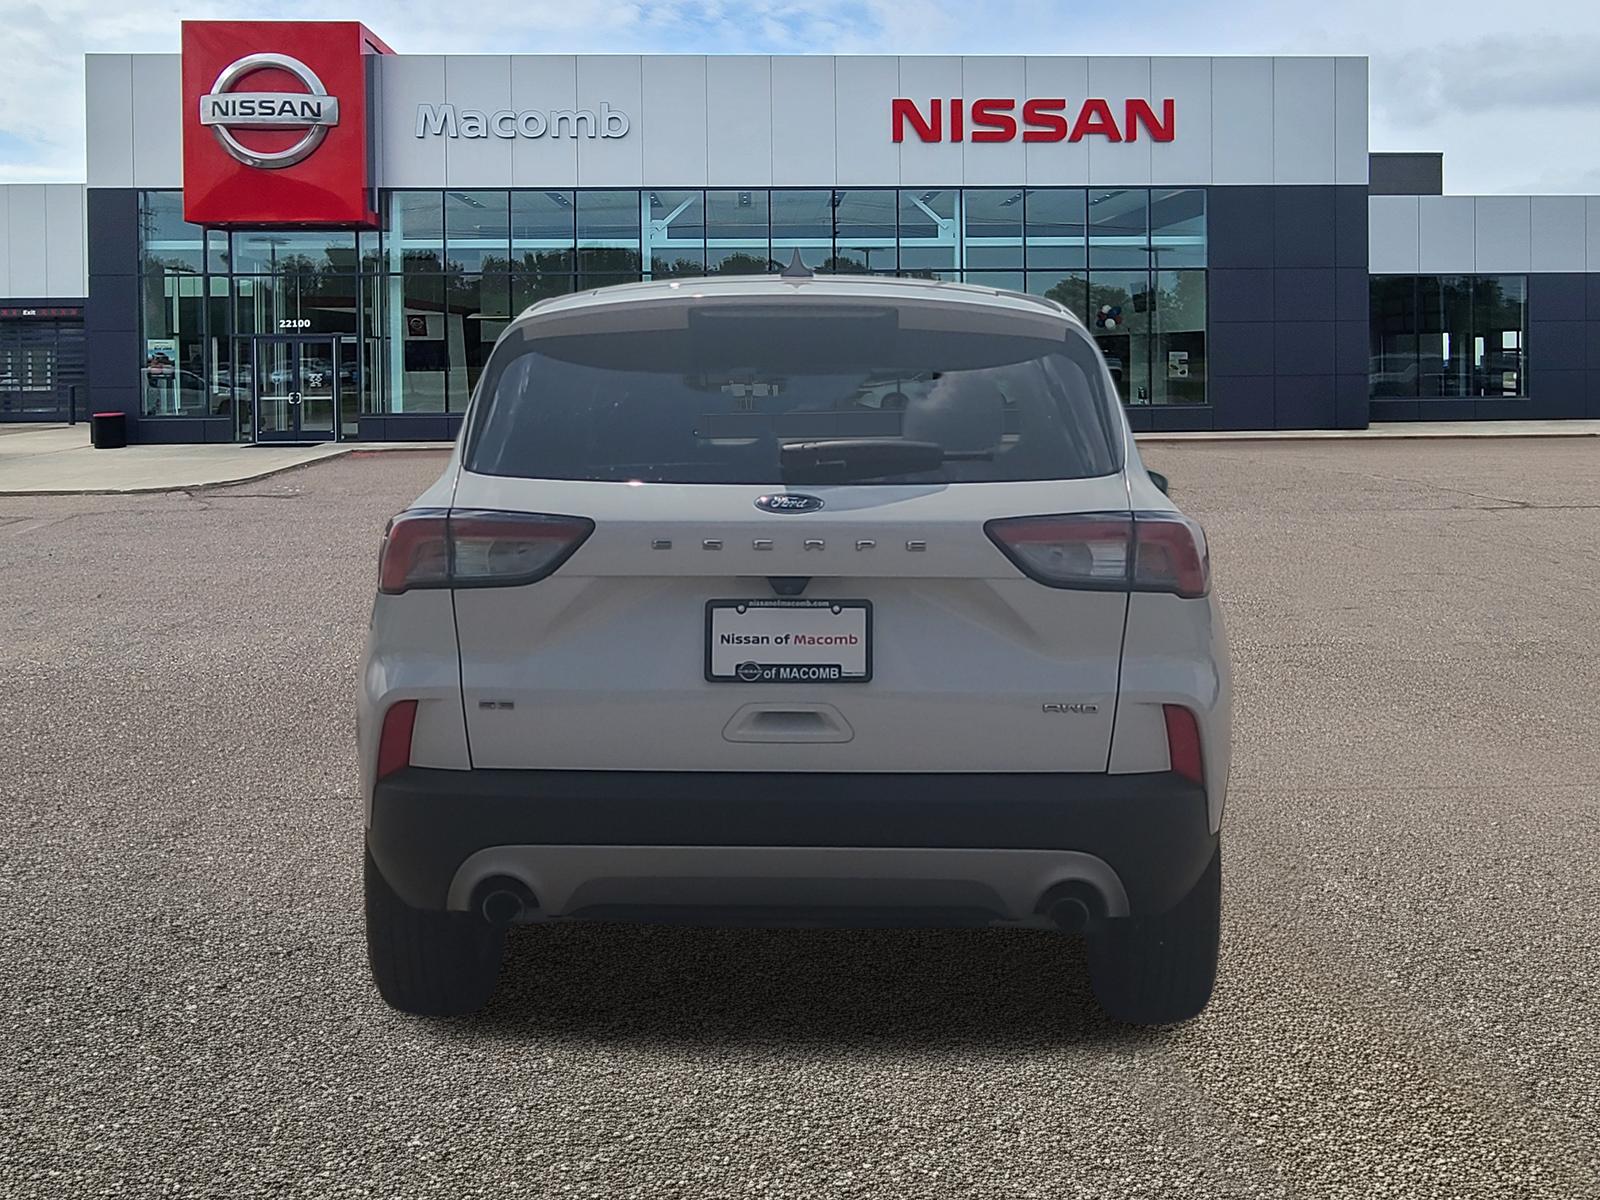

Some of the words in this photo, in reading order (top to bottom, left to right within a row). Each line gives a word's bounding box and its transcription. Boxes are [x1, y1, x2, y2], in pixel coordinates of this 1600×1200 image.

[212, 100, 322, 118] NISSAN
[415, 102, 630, 139] Macomb
[892, 98, 1175, 143] NISSAN
[279, 319, 311, 328] 22100
[770, 495, 808, 508] Ford
[720, 633, 770, 645] Nissan
[774, 633, 790, 645] of
[794, 634, 858, 645] Macomb
[763, 667, 776, 679] of
[779, 667, 839, 679] MACOMB
